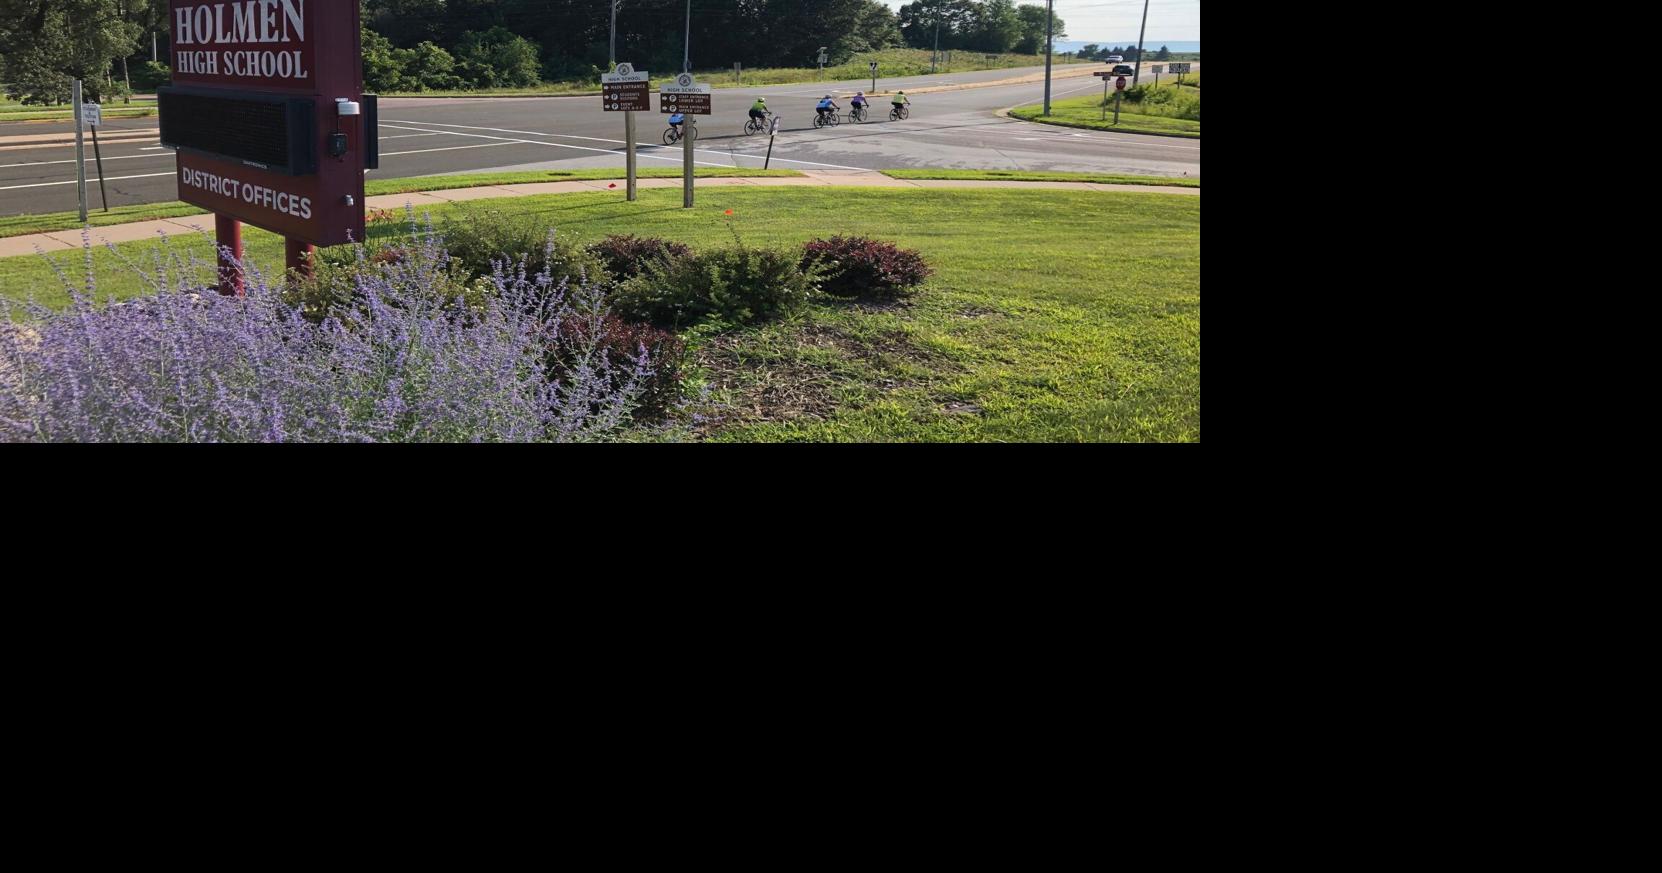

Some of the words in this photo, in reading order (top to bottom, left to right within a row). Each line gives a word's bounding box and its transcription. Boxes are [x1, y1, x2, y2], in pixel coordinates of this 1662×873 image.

[175, 0, 305, 45] HOLMEN
[177, 50, 219, 74] HIGH
[224, 50, 308, 79] SCHOOL
[182, 167, 240, 199] DISTRICT
[242, 183, 312, 220] OFFICES
